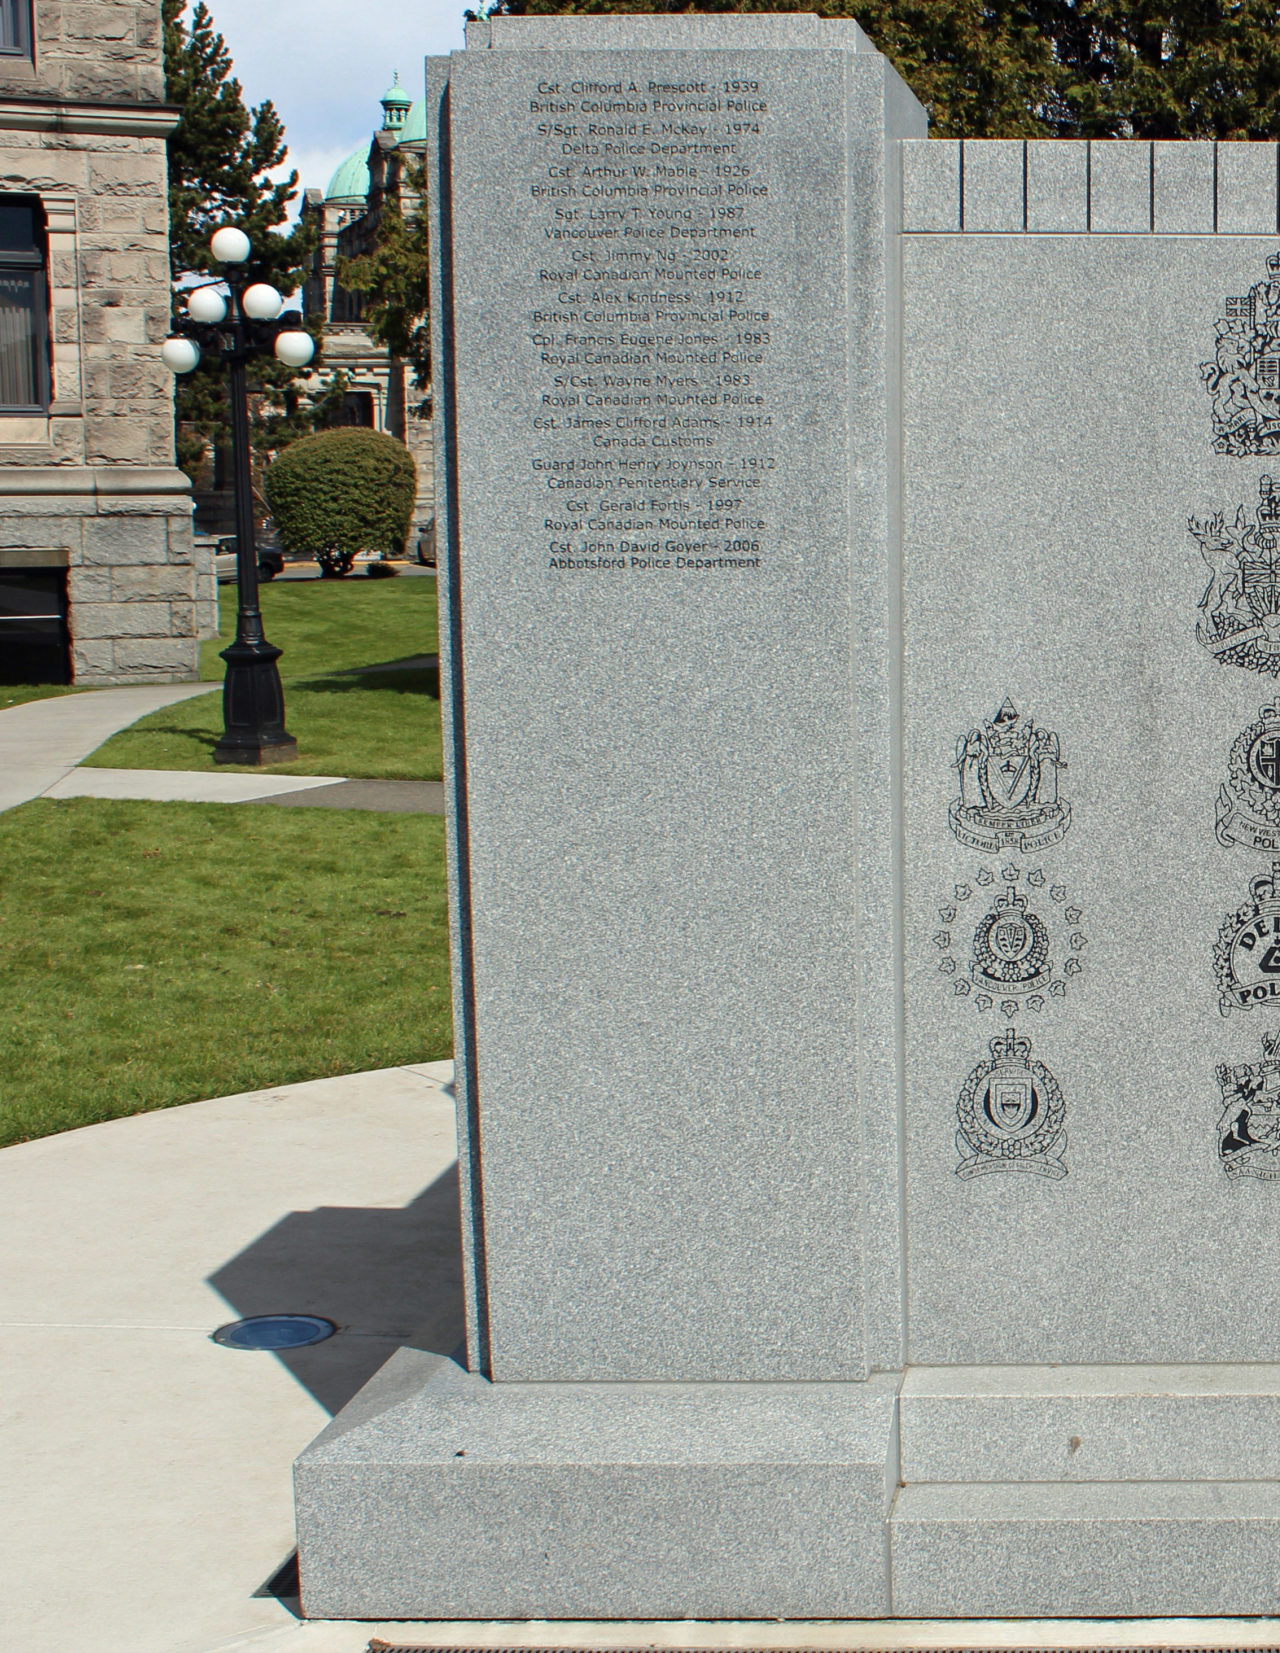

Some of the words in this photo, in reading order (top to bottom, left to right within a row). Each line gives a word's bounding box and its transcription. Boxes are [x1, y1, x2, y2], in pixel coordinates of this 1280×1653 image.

[571, 82, 623, 94] Clifford
[648, 81, 707, 94] Prescott
[722, 80, 759, 93] 1939
[530, 101, 575, 113] British
[580, 100, 647, 112] Columbia
[653, 100, 721, 112] Provincial
[727, 100, 767, 112] Police
[562, 143, 599, 155] Delta
[605, 143, 645, 155] Police
[650, 142, 737, 157] Department
[544, 227, 619, 240] Vancouver
[624, 227, 665, 239] Police
[670, 226, 756, 241] Department
[539, 269, 578, 284] Royal
[583, 269, 649, 281] Canadian
[654, 268, 716, 280] Mounted
[721, 268, 762, 280] Police
[565, 334, 615, 346] Francis
[620, 333, 673, 348] Eugene
[678, 333, 718, 345] Jones
[736, 333, 770, 345] 1983
[604, 375, 651, 389] Wayne
[656, 375, 698, 389] Myers
[715, 374, 750, 386] 1983
[564, 417, 611, 429] James
[616, 416, 667, 428] Clifford
[672, 416, 720, 428] Adams
[737, 416, 773, 428] 1914
[593, 435, 646, 447] Canada
[651, 435, 713, 447] Customs
[532, 459, 575, 471] Guard
[580, 459, 613, 471] John
[618, 458, 661, 473] Henry
[740, 458, 776, 470] 1912
[547, 477, 613, 489] Canadian
[619, 476, 703, 491] Penitentiary
[708, 476, 761, 488] Service
[599, 500, 646, 512] Gerald
[707, 499, 742, 511] 1997
[544, 518, 583, 533] Royal
[588, 518, 653, 530] Canadian
[658, 518, 720, 530] Mounted
[725, 517, 766, 529] Police
[581, 541, 615, 553] John
[620, 540, 660, 553] David
[723, 540, 760, 552] 2006
[549, 557, 626, 569] Abbotsford
[631, 557, 671, 569] Police
[676, 556, 761, 571] Department
[1239, 821, 1257, 833] NEW
[1024, 831, 1059, 850] POLICE
[975, 974, 1016, 991] VANCOUVER
[1023, 975, 1047, 991] POLICE
